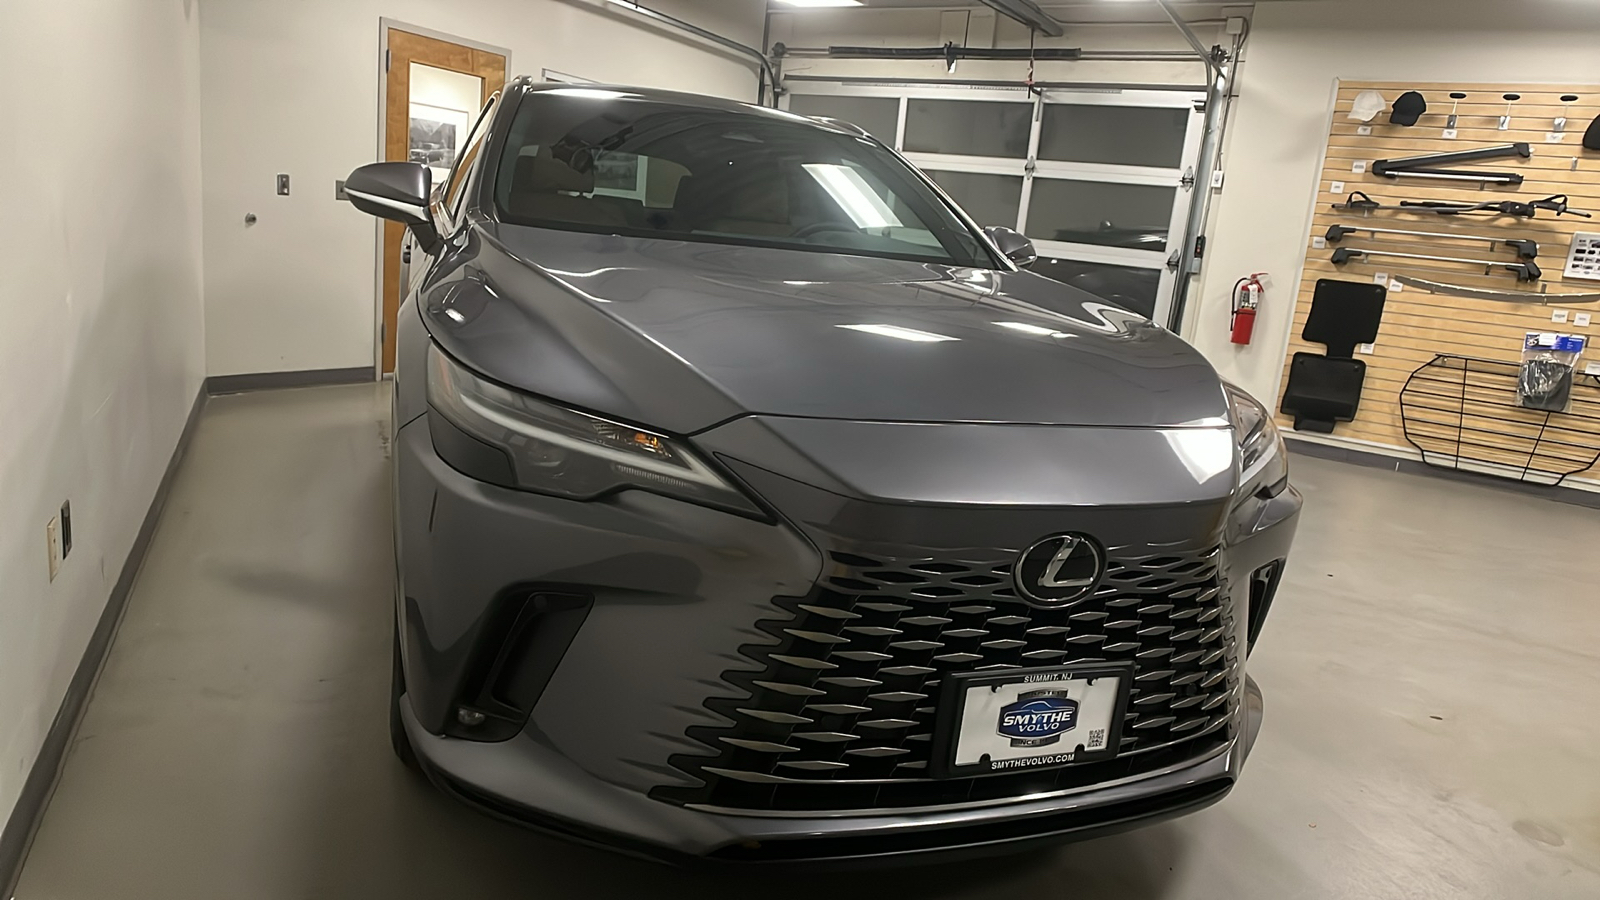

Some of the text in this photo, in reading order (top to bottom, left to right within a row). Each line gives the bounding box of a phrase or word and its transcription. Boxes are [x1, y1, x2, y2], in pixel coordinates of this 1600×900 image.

[1061, 673, 1073, 681] NJ
[1003, 712, 1072, 726] SMYTHE
[1018, 723, 1060, 732] VOLVO
[991, 754, 1075, 769] SMYTHEVOLVO.COM
